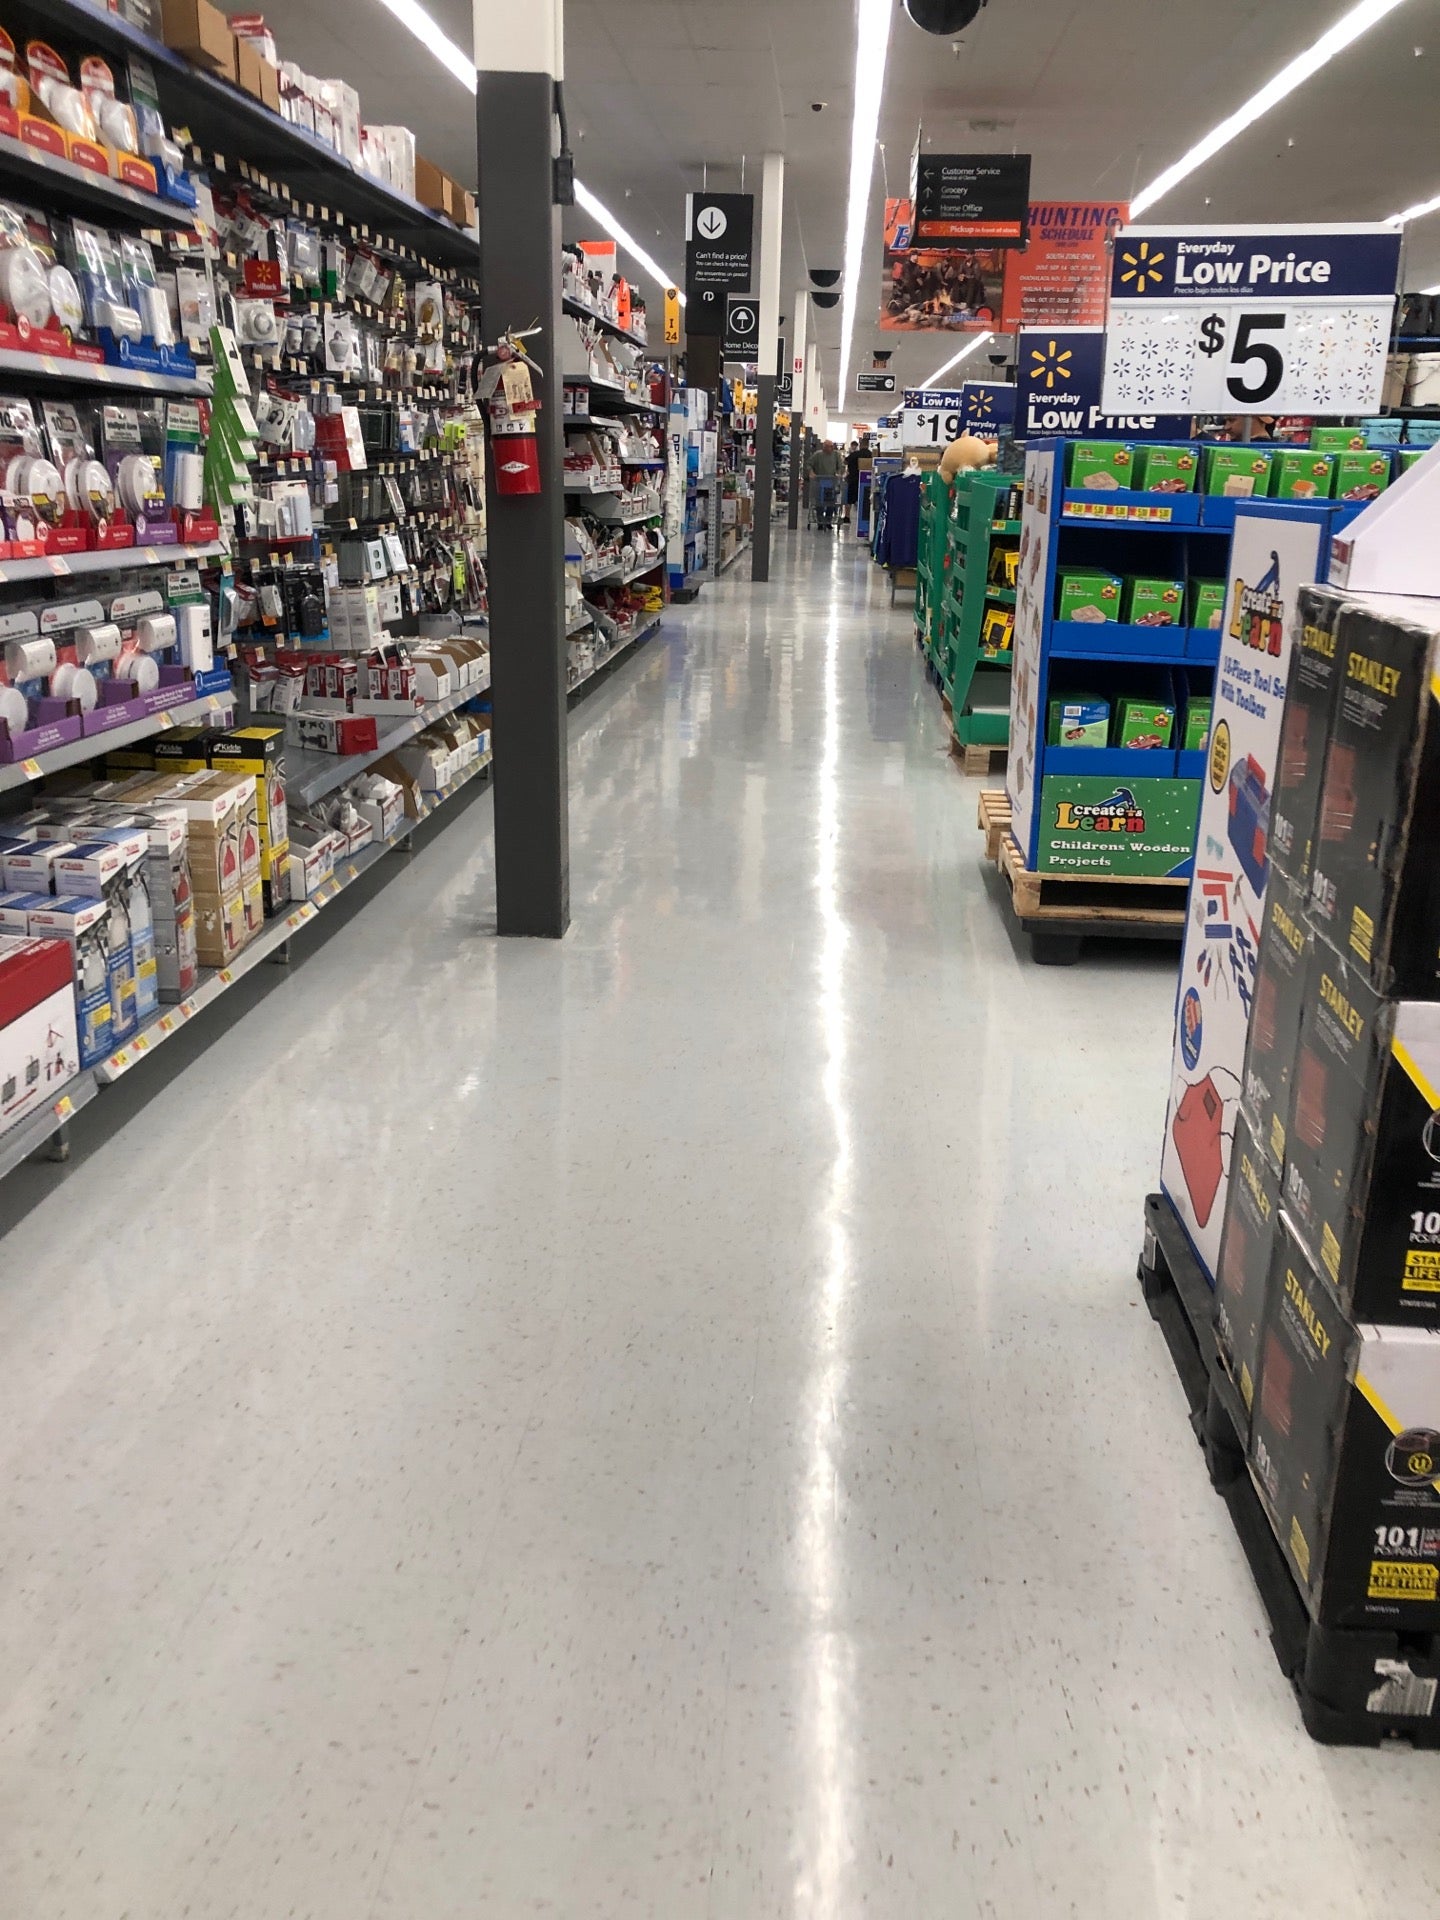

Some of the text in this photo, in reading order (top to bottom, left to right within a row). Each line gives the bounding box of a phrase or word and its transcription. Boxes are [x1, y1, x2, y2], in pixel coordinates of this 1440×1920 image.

[941, 167, 1001, 175] Customer Service
[941, 185, 968, 196] Grocery
[940, 204, 983, 213] Home Office
[1028, 207, 1119, 227] HUNTING
[950, 225, 975, 235] Pickup
[1040, 228, 1094, 240] SCHEDULE
[1177, 242, 1235, 256] Everyday
[695, 252, 711, 260] Can't
[712, 252, 725, 260] find
[730, 253, 748, 262] price?
[1175, 253, 1331, 284] Low Price
[252, 282, 278, 291] Rollback
[665, 331, 678, 341] 24
[742, 341, 759, 350] Déco
[1199, 313, 1286, 404] $5
[922, 397, 944, 407] Low
[1029, 393, 1081, 406] Everyday
[1027, 405, 1084, 429] Low
[966, 420, 997, 428] Everyday
[1302, 624, 1338, 659] STANLE
[1347, 651, 1402, 698] STANLEY
[1254, 668, 1272, 694] Tool
[1273, 676, 1287, 700] Se
[1236, 687, 1267, 719] Toolbox
[221, 743, 242, 751] Kidde
[1073, 805, 1125, 816] create
[1055, 802, 1145, 833] Learn
[1050, 840, 1190, 853] Childrens Wooden
[1049, 856, 1111, 867] Projects
[1272, 902, 1305, 956] STANLEY
[1319, 973, 1365, 1042] STANLEY
[1241, 1153, 1272, 1222] STANLEY
[1284, 1268, 1331, 1360] STANLEY
[1374, 1525, 1420, 1548] 101
[1377, 1565, 1434, 1576] STANLEY
